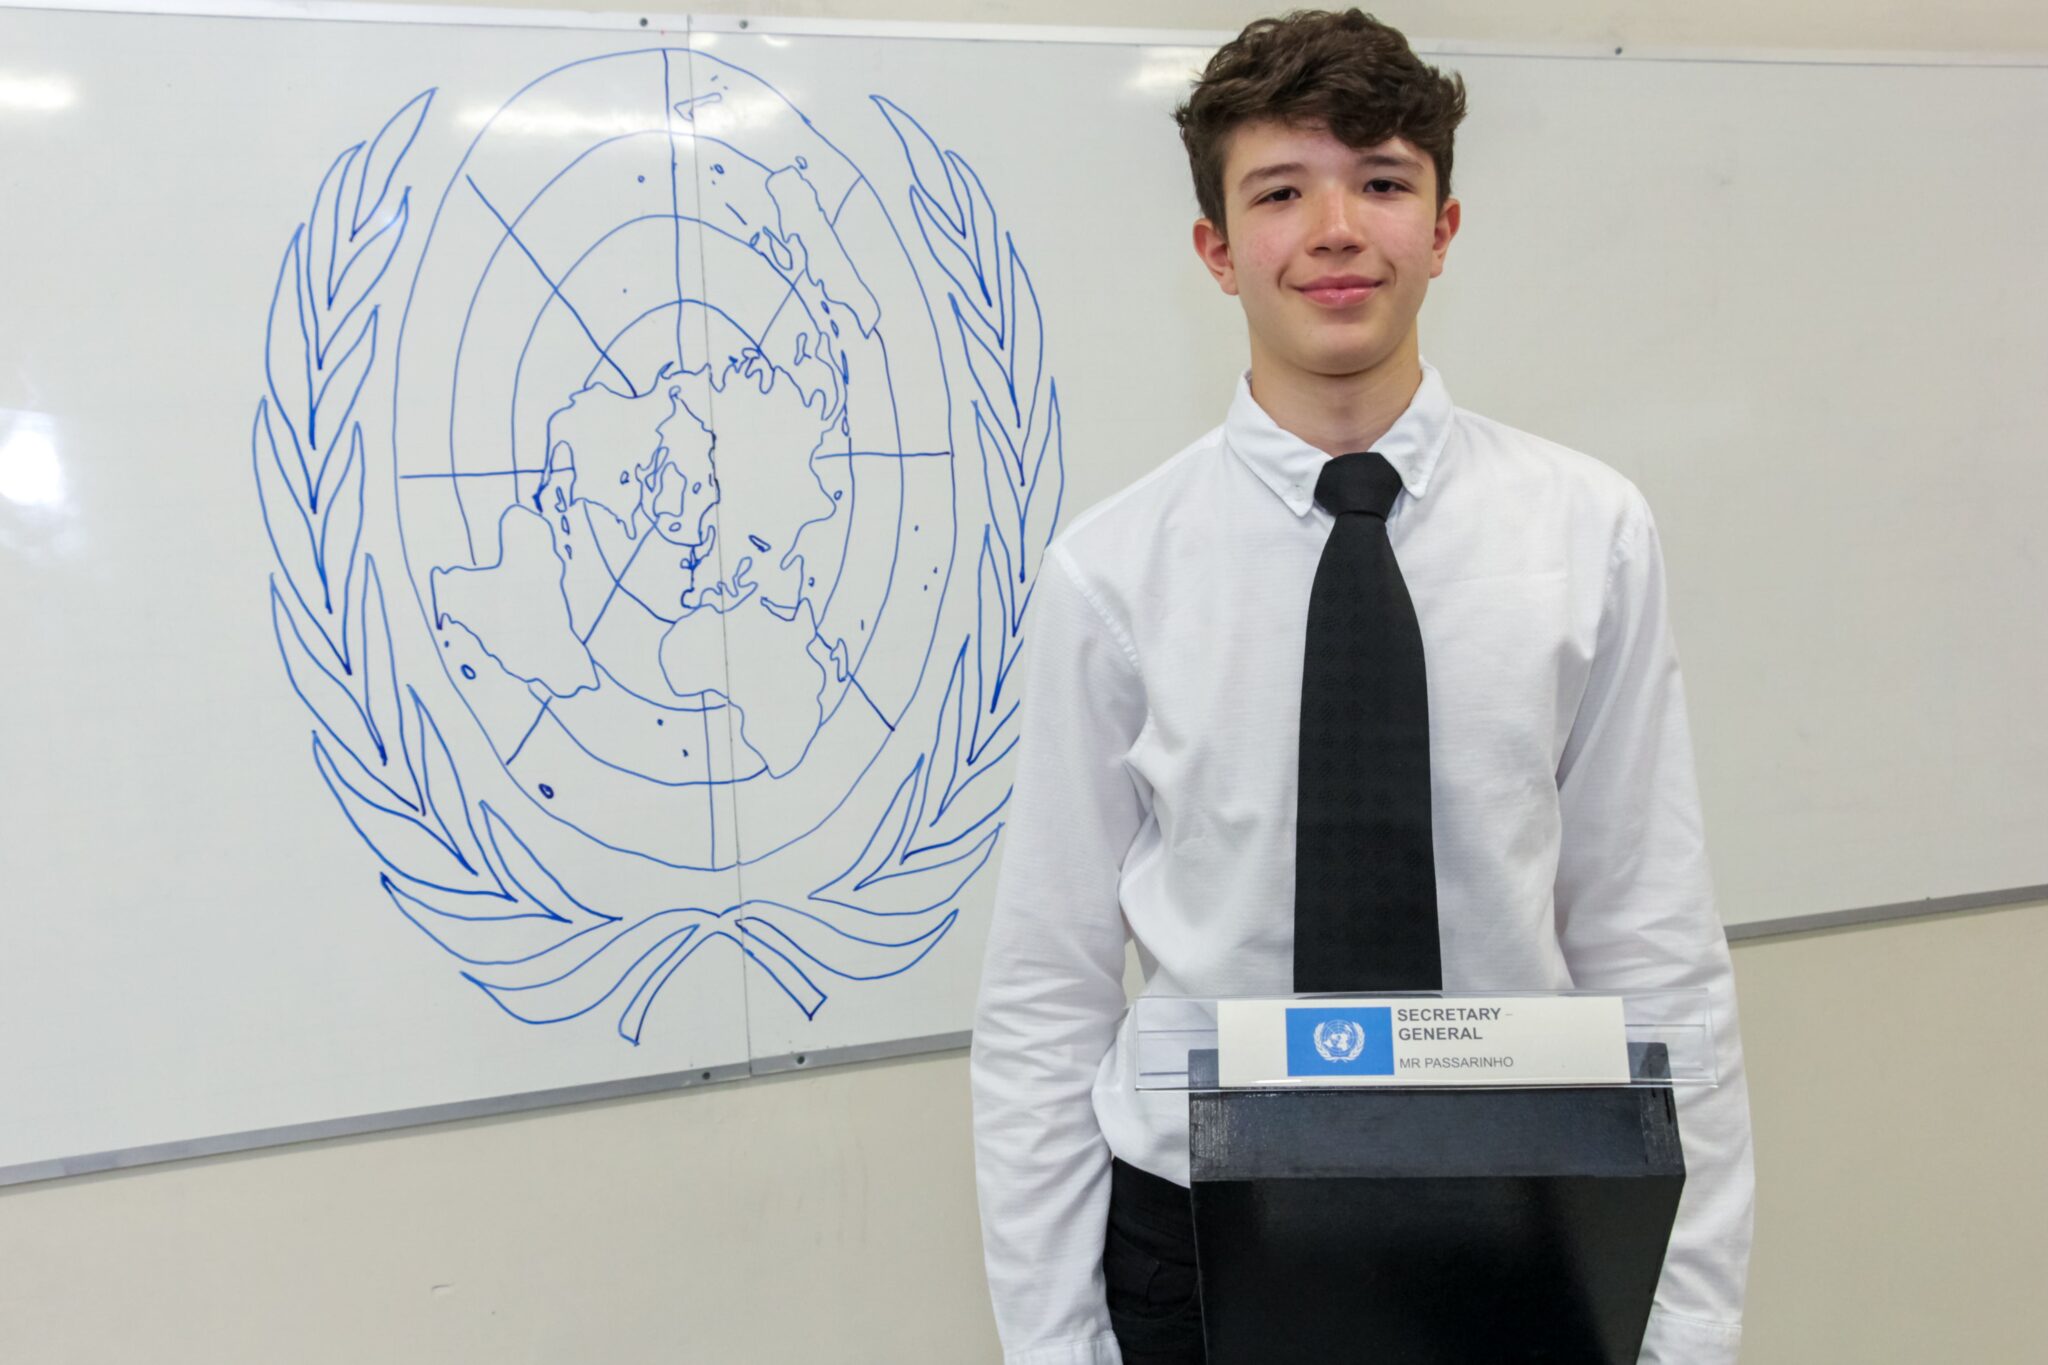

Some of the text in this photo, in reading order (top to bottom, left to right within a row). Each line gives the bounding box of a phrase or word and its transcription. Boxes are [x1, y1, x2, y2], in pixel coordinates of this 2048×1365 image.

[1397, 1007, 1501, 1021] SECRETARY
[1398, 1027, 1483, 1041] GENERAL
[1399, 1056, 1514, 1069] MR PASSARINHO
